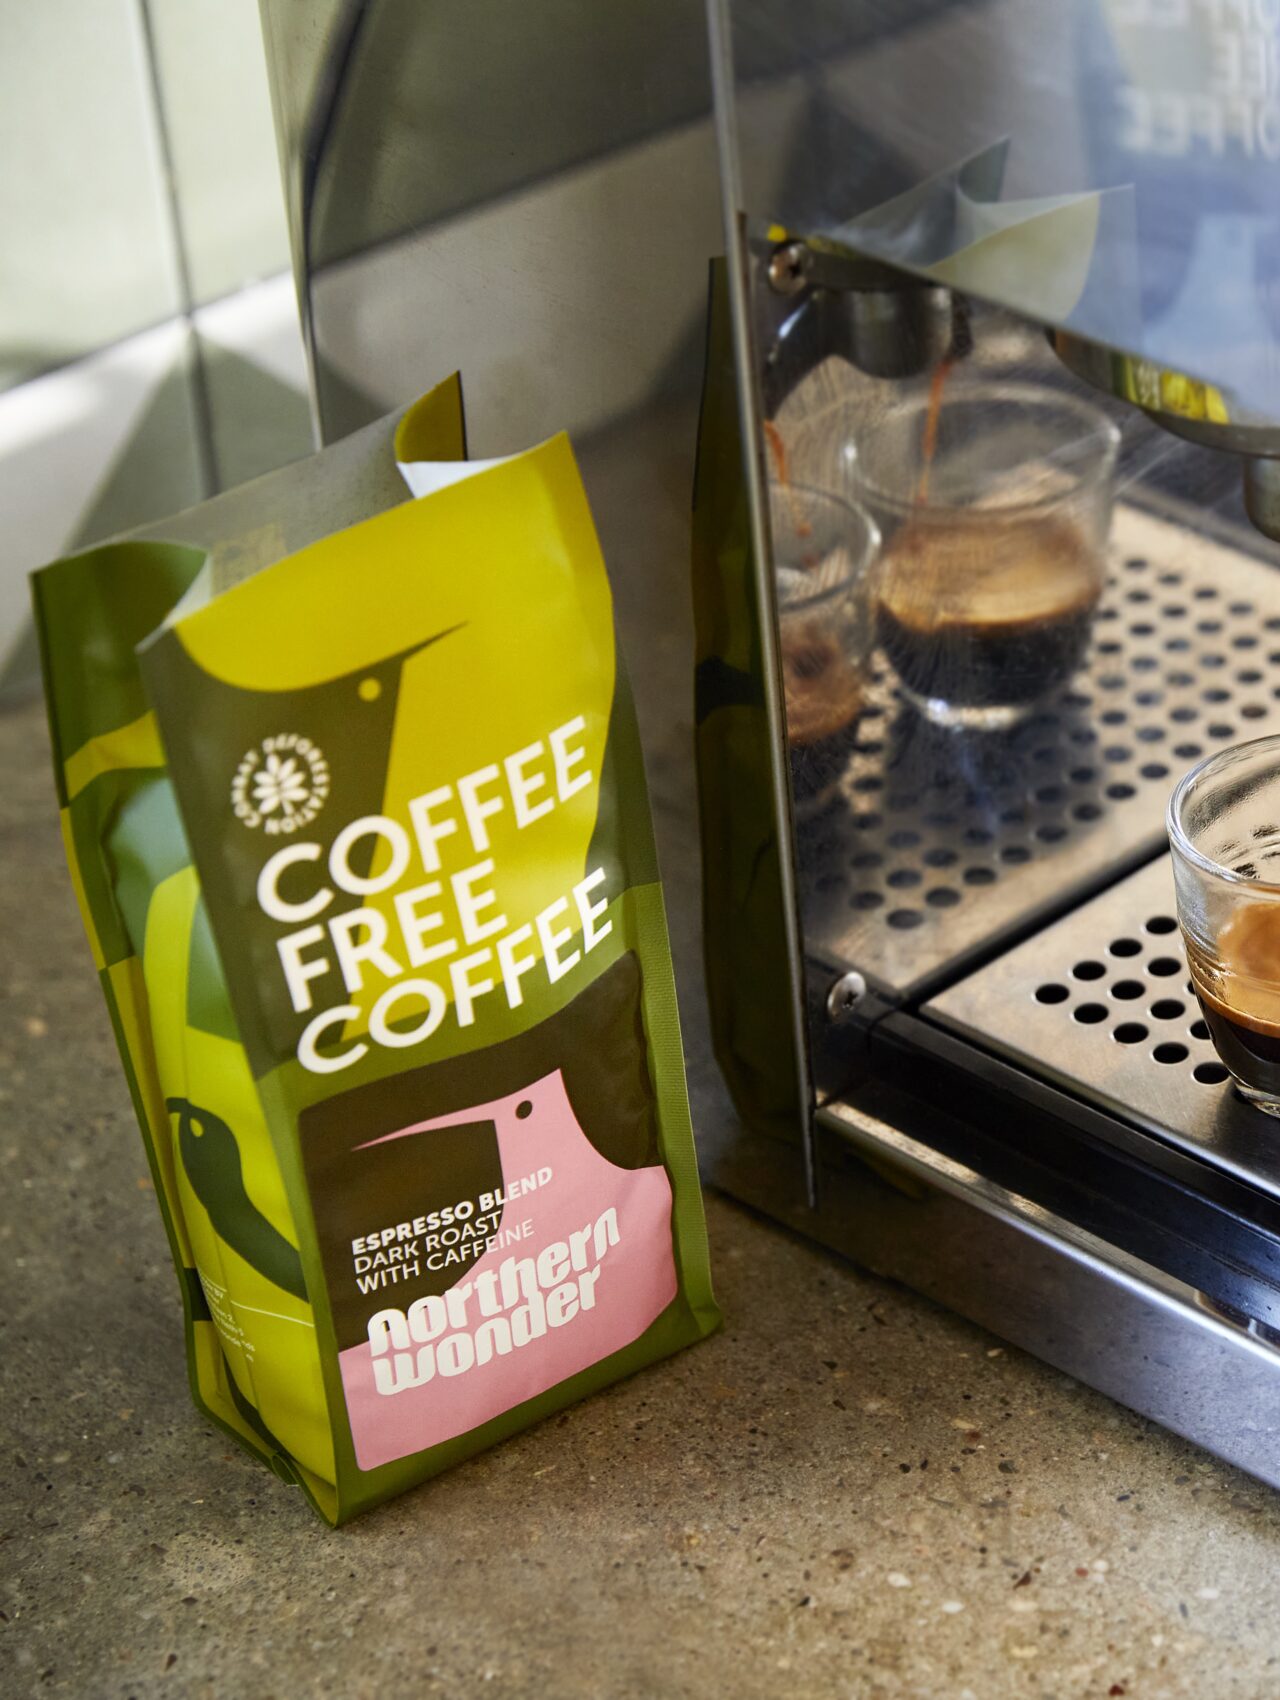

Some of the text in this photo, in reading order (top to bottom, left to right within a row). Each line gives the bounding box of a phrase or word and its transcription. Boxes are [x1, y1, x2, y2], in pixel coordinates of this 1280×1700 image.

[231, 733, 330, 835] COMBAT DEFORESTATION
[257, 715, 593, 923] COFFEE
[276, 858, 508, 1013] FREE
[297, 867, 613, 1074] COFFEE
[351, 1166, 553, 1256] ESPRESSO BLEND
[354, 1210, 502, 1275] DARK ROAST
[356, 1218, 535, 1295] WITH CAFFEINE
[367, 1207, 621, 1357] northern
[371, 1264, 601, 1396] wonder
